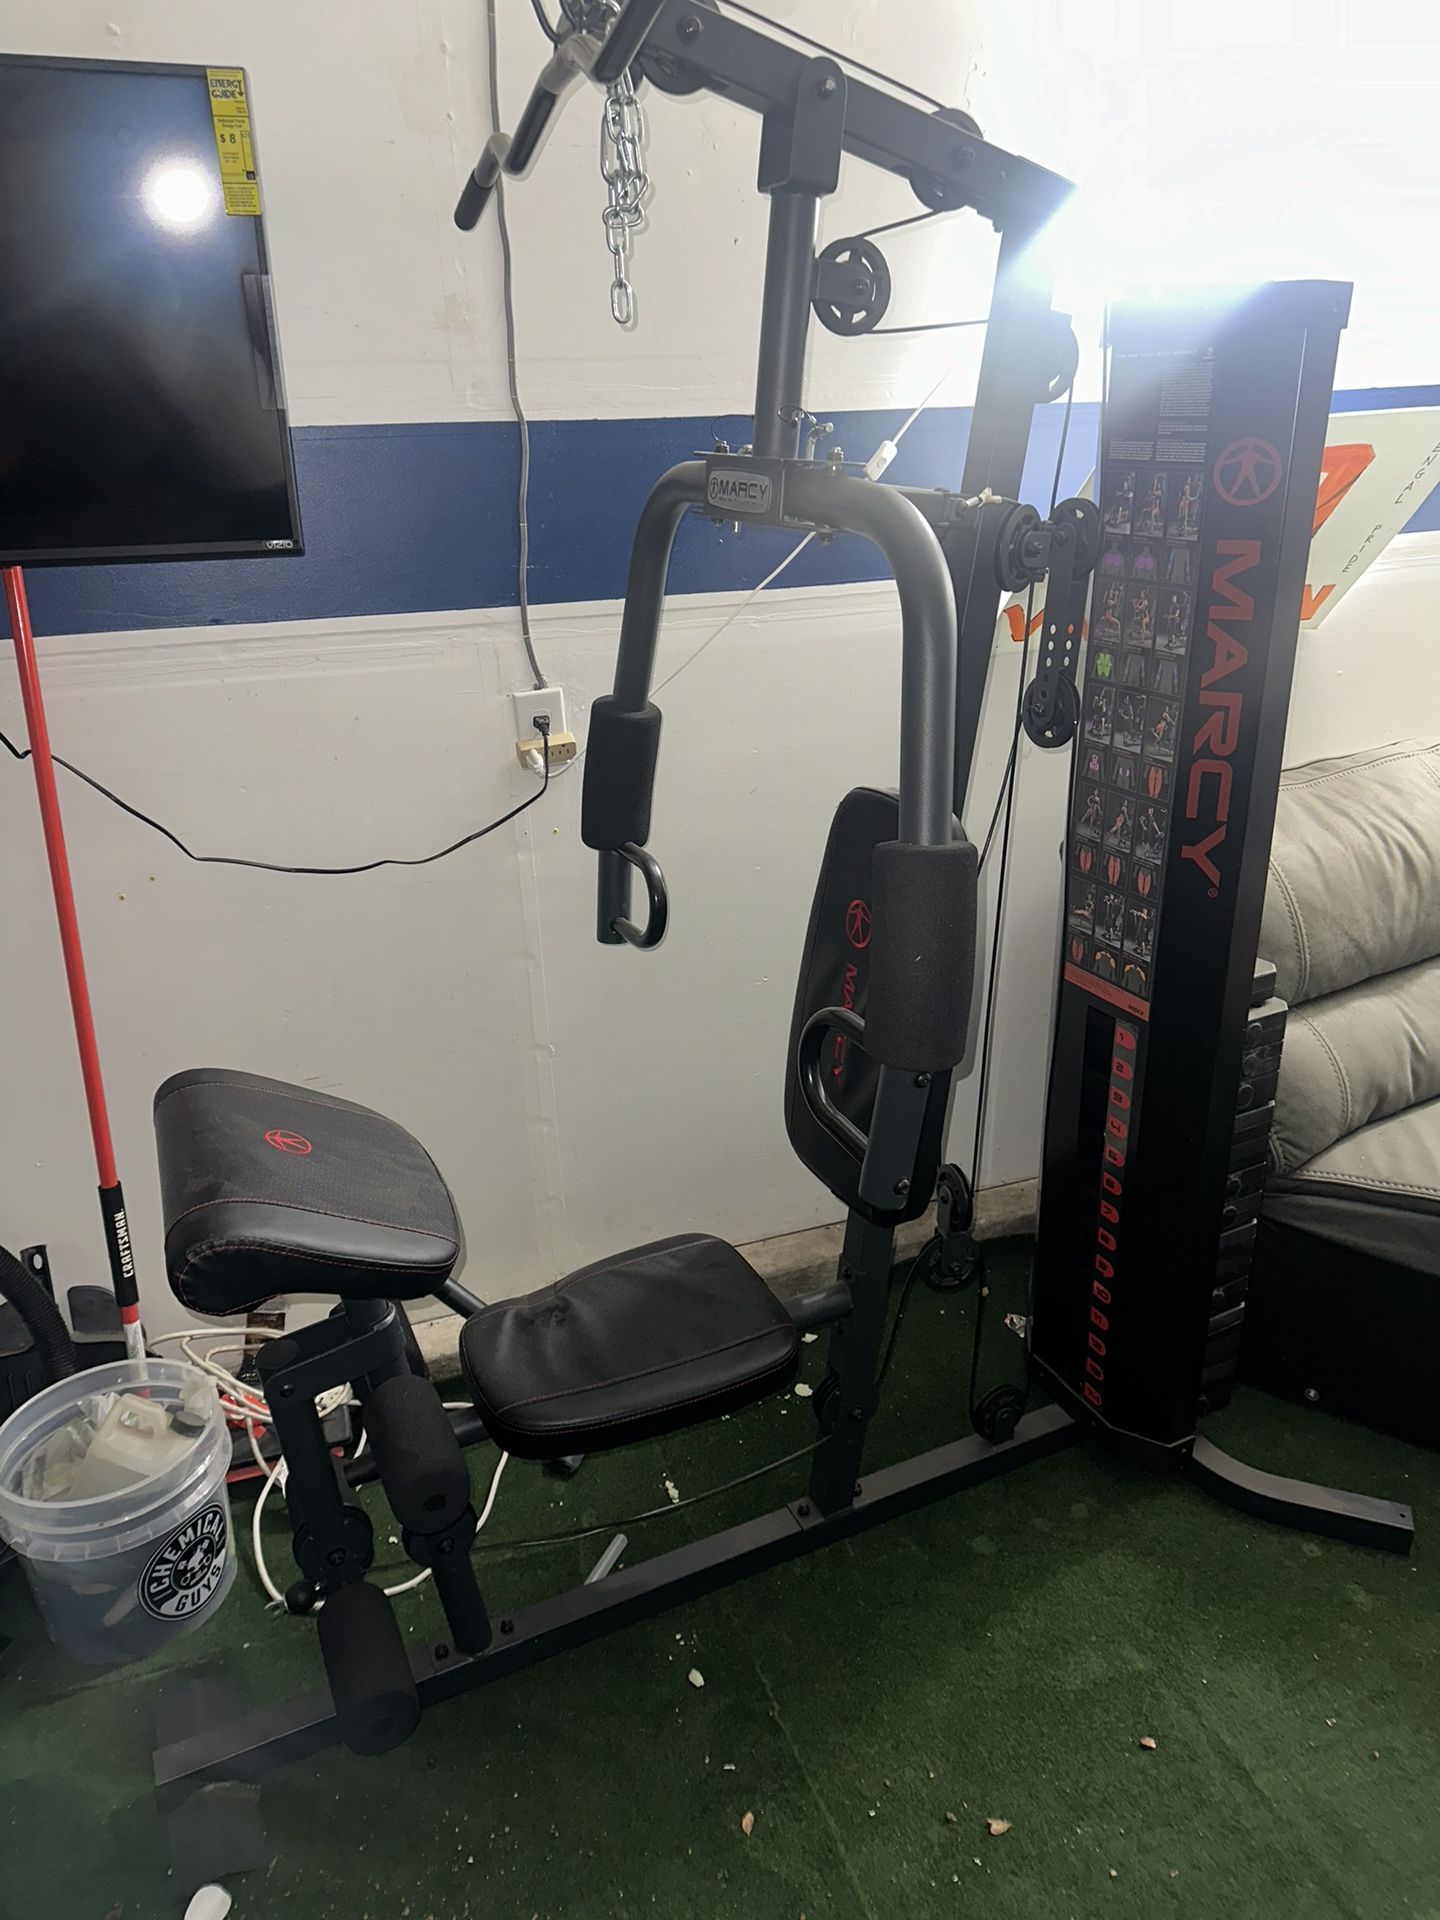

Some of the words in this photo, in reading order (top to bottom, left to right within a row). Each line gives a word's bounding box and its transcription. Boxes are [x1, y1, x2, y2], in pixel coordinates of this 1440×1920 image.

[211, 89, 238, 99] GUIDE
[229, 133, 237, 144] 8
[719, 479, 768, 500] MARCY
[266, 540, 293, 549] VIZIO
[1342, 524, 1383, 573] PRIDE
[1181, 539, 1262, 889] MARCY
[833, 962, 858, 1089] MACY
[150, 1513, 224, 1594] CHEMICAL
[175, 1565, 221, 1612] GUYS
